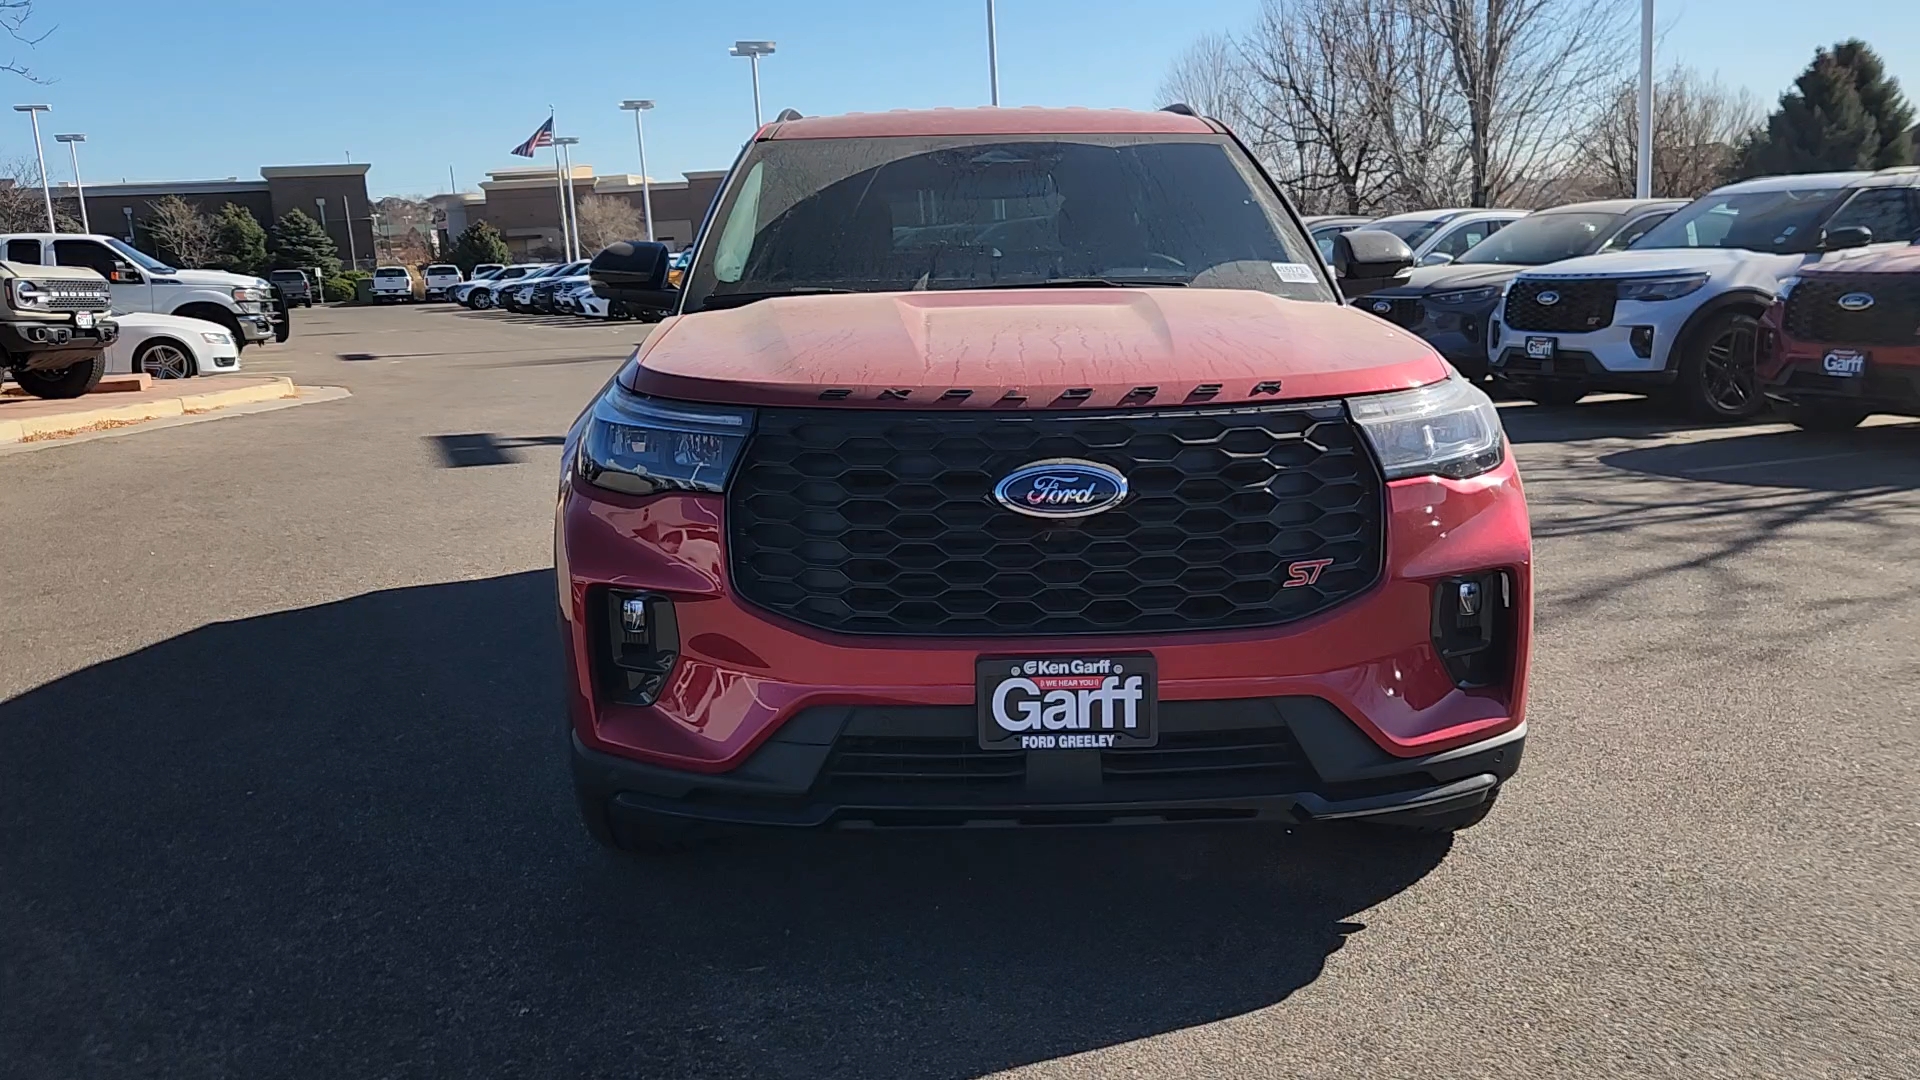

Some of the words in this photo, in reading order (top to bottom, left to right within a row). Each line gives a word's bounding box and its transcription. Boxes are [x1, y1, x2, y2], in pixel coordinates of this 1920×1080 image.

[818, 380, 1282, 403] EXPLORER
[1026, 475, 1097, 505] Ford
[1283, 558, 1334, 588] ST
[1038, 660, 1070, 675] Ken
[1070, 659, 1111, 674] Garff
[1045, 679, 1058, 687] WE
[1058, 679, 1078, 687] HEAR
[1078, 679, 1094, 687] YOU
[992, 675, 1143, 732] Garff
[1021, 734, 1056, 749] FORD
[1058, 734, 1115, 748] GREELEY
